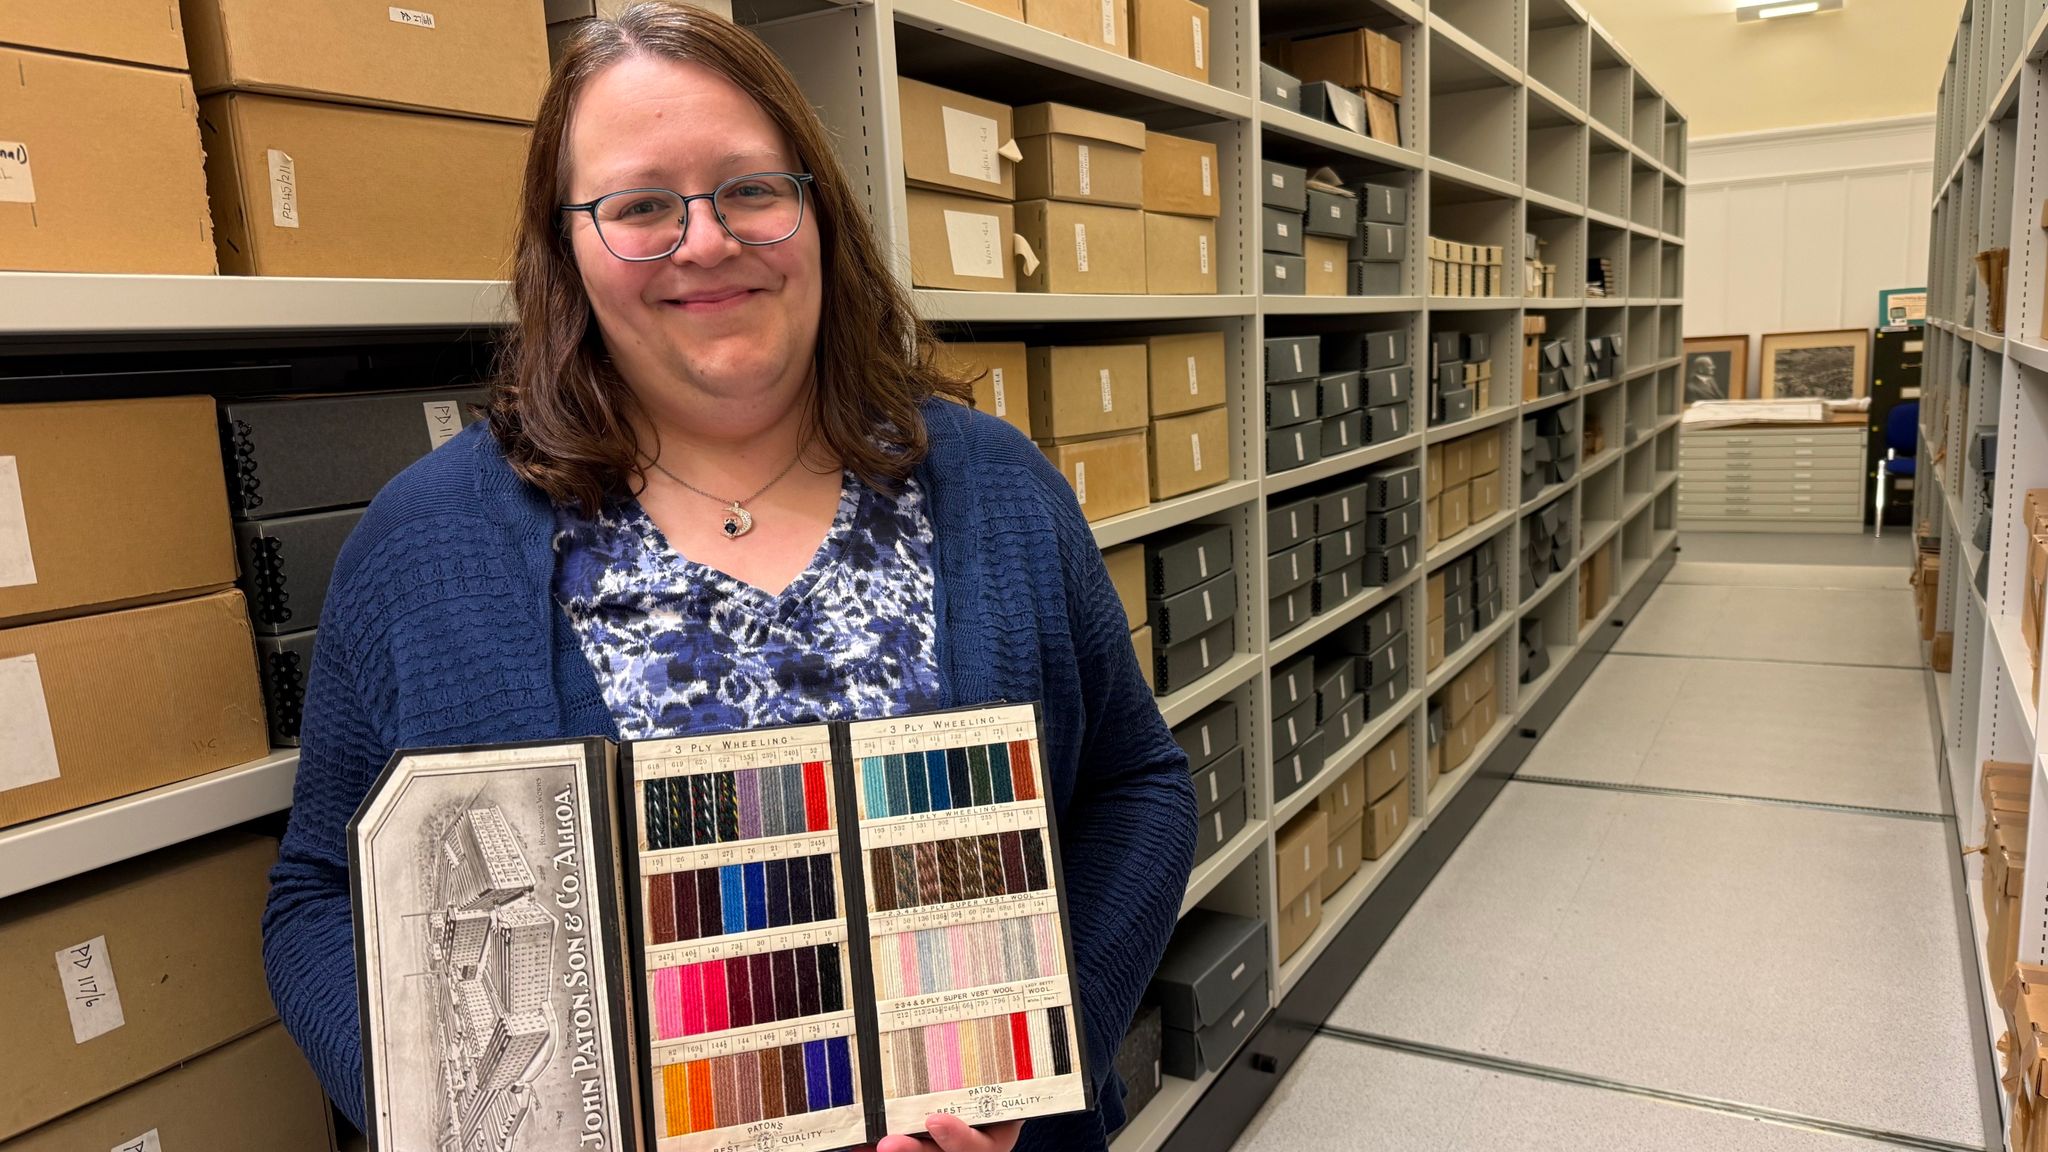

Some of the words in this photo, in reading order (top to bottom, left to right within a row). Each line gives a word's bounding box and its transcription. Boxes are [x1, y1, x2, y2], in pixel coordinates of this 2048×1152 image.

[890, 725, 896, 734] 3
[904, 724, 924, 732] PLY
[933, 716, 995, 729] WHEELING
[675, 745, 682, 754] 3
[691, 744, 712, 753] PLY
[722, 736, 788, 750] WHEELING
[945, 805, 997, 817] WHEELING
[950, 900, 978, 909] SUPER
[984, 896, 1004, 904] VEST
[565, 912, 585, 932] &
[70, 944, 93, 969] PD
[563, 937, 590, 988] SON
[76, 975, 106, 1008] 117/6
[943, 992, 968, 1002] SUPER
[971, 989, 989, 997] VEST
[992, 986, 1015, 994] WOOL
[1001, 1096, 1041, 1108] QUALITY
[580, 1078, 606, 1150] JOHN
[781, 1130, 823, 1144] QUALITY
